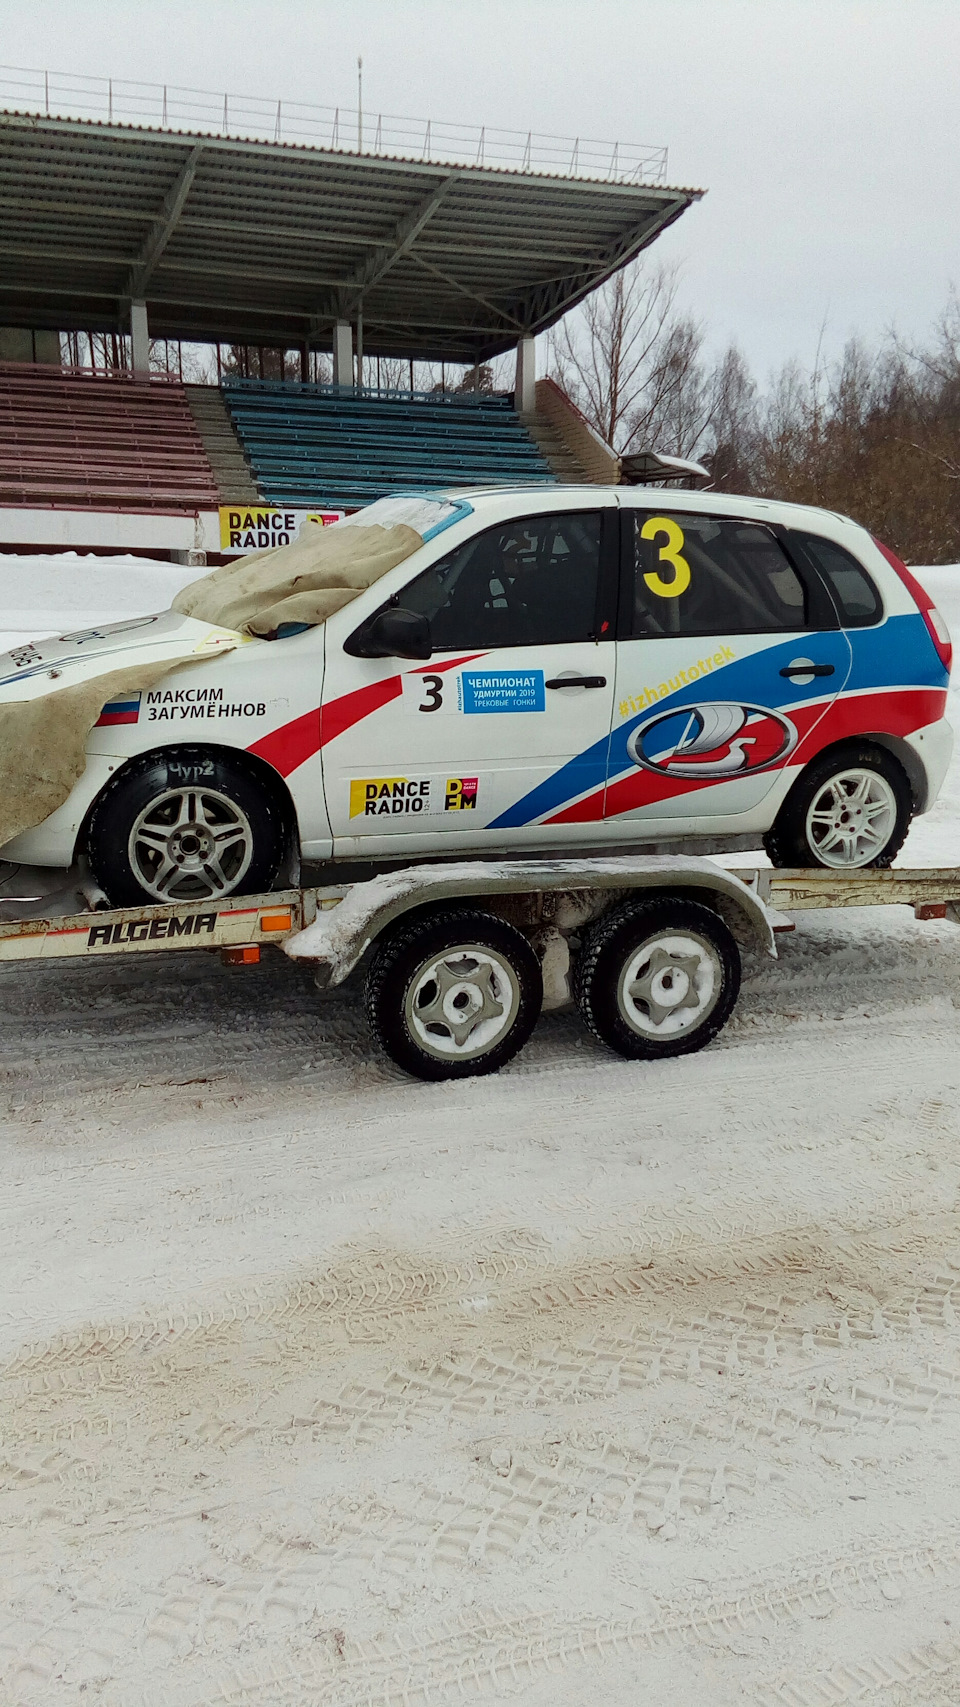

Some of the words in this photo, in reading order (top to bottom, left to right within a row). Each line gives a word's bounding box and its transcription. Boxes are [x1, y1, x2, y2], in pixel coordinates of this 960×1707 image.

[229, 512, 296, 530] DANCE
[230, 531, 290, 548] RADIO
[640, 517, 691, 598] 3
[468, 677, 536, 688] ЧЕМПИОНАТ
[618, 645, 736, 718] #izhautotrek
[146, 688, 223, 704] МАКСИМ
[418, 675, 444, 713] 3
[473, 690, 517, 699] УДМУРТИИ
[519, 689, 536, 697] 2019
[474, 699, 509, 707] ТРЕКОВЫЕ
[148, 702, 266, 721] ЗАГУМЁННОВ
[365, 781, 431, 799] DANCE
[365, 797, 423, 815] RADIO
[87, 912, 218, 947] ALGEMA
